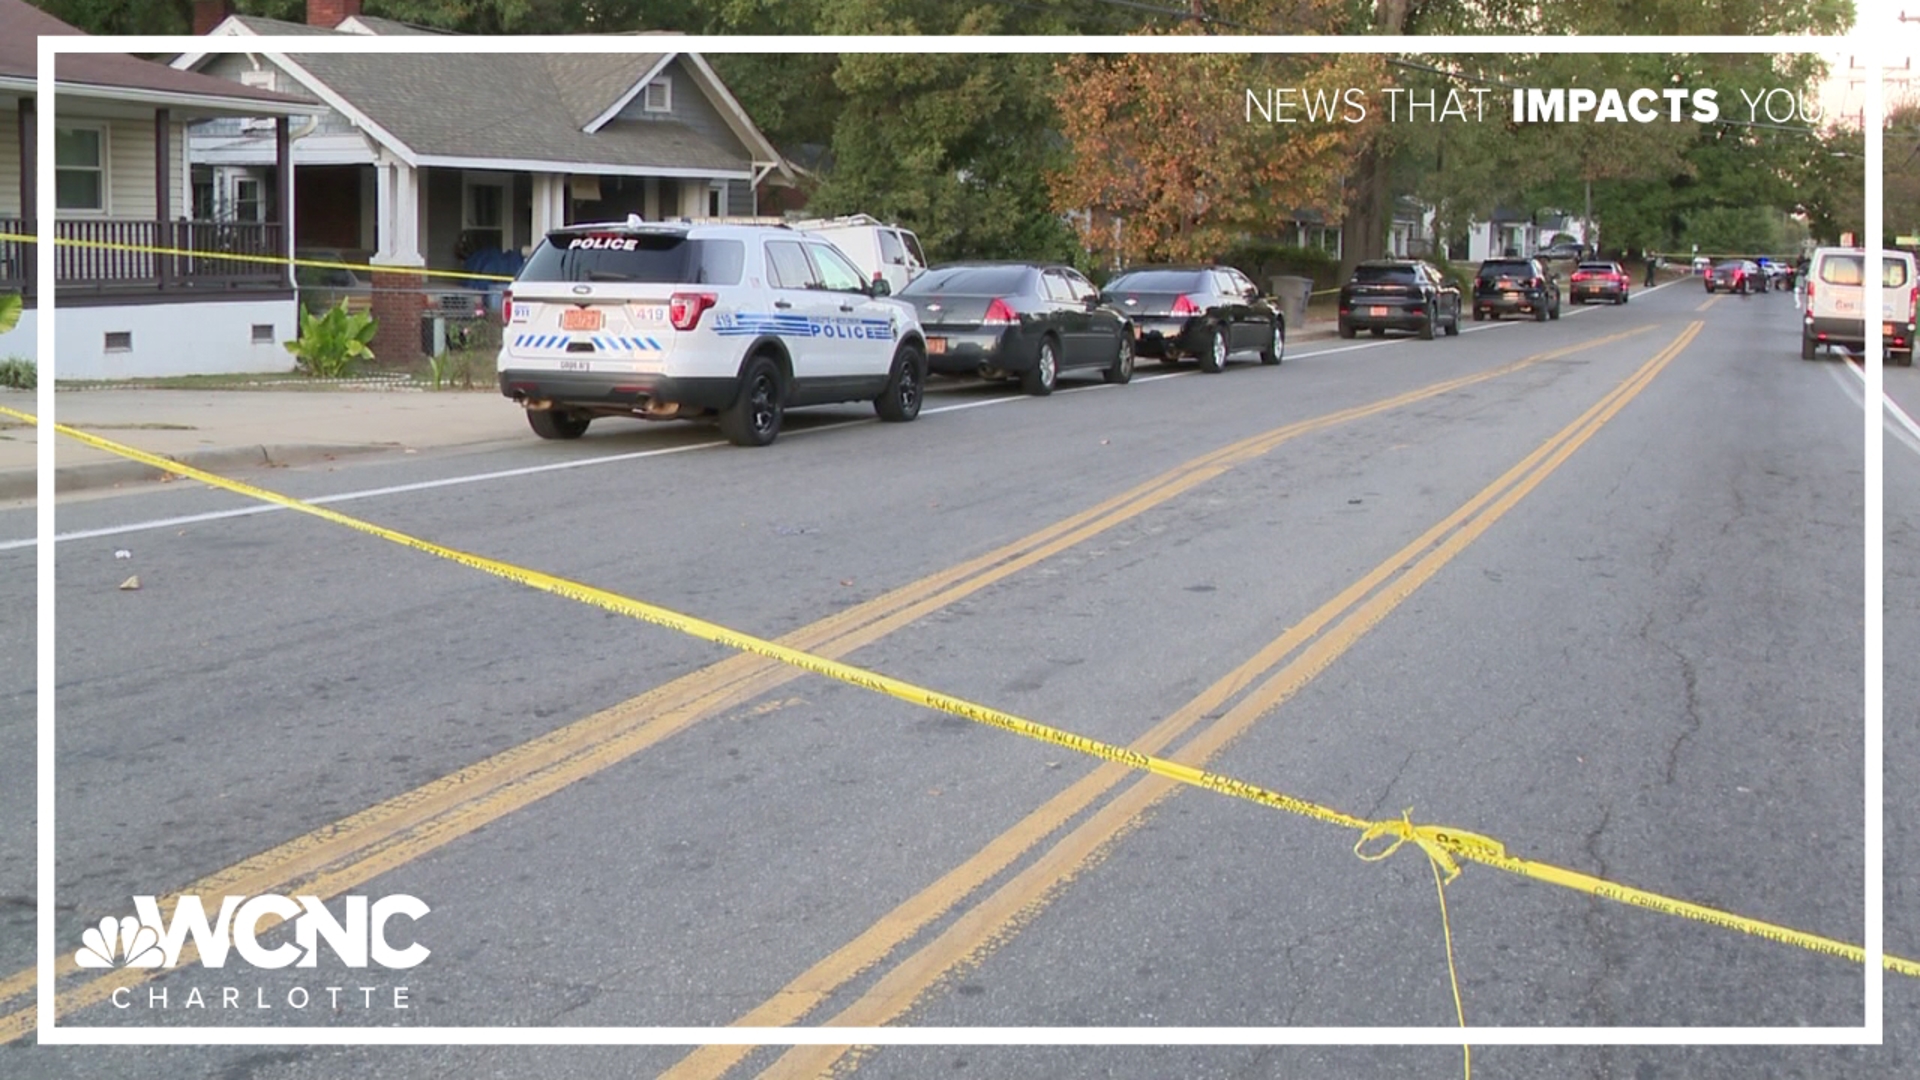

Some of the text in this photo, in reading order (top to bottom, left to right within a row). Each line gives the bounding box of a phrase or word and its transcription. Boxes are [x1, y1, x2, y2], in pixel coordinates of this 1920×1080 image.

[568, 237, 638, 251] POLICE
[636, 308, 664, 320] 419
[715, 313, 733, 328] 419
[810, 323, 876, 339] POLICE
[1593, 885, 1625, 900] CALL
[1629, 895, 1672, 912] CRIME
[1674, 905, 1746, 932] STOPPERS
[1786, 934, 1865, 962] INFORMATI
